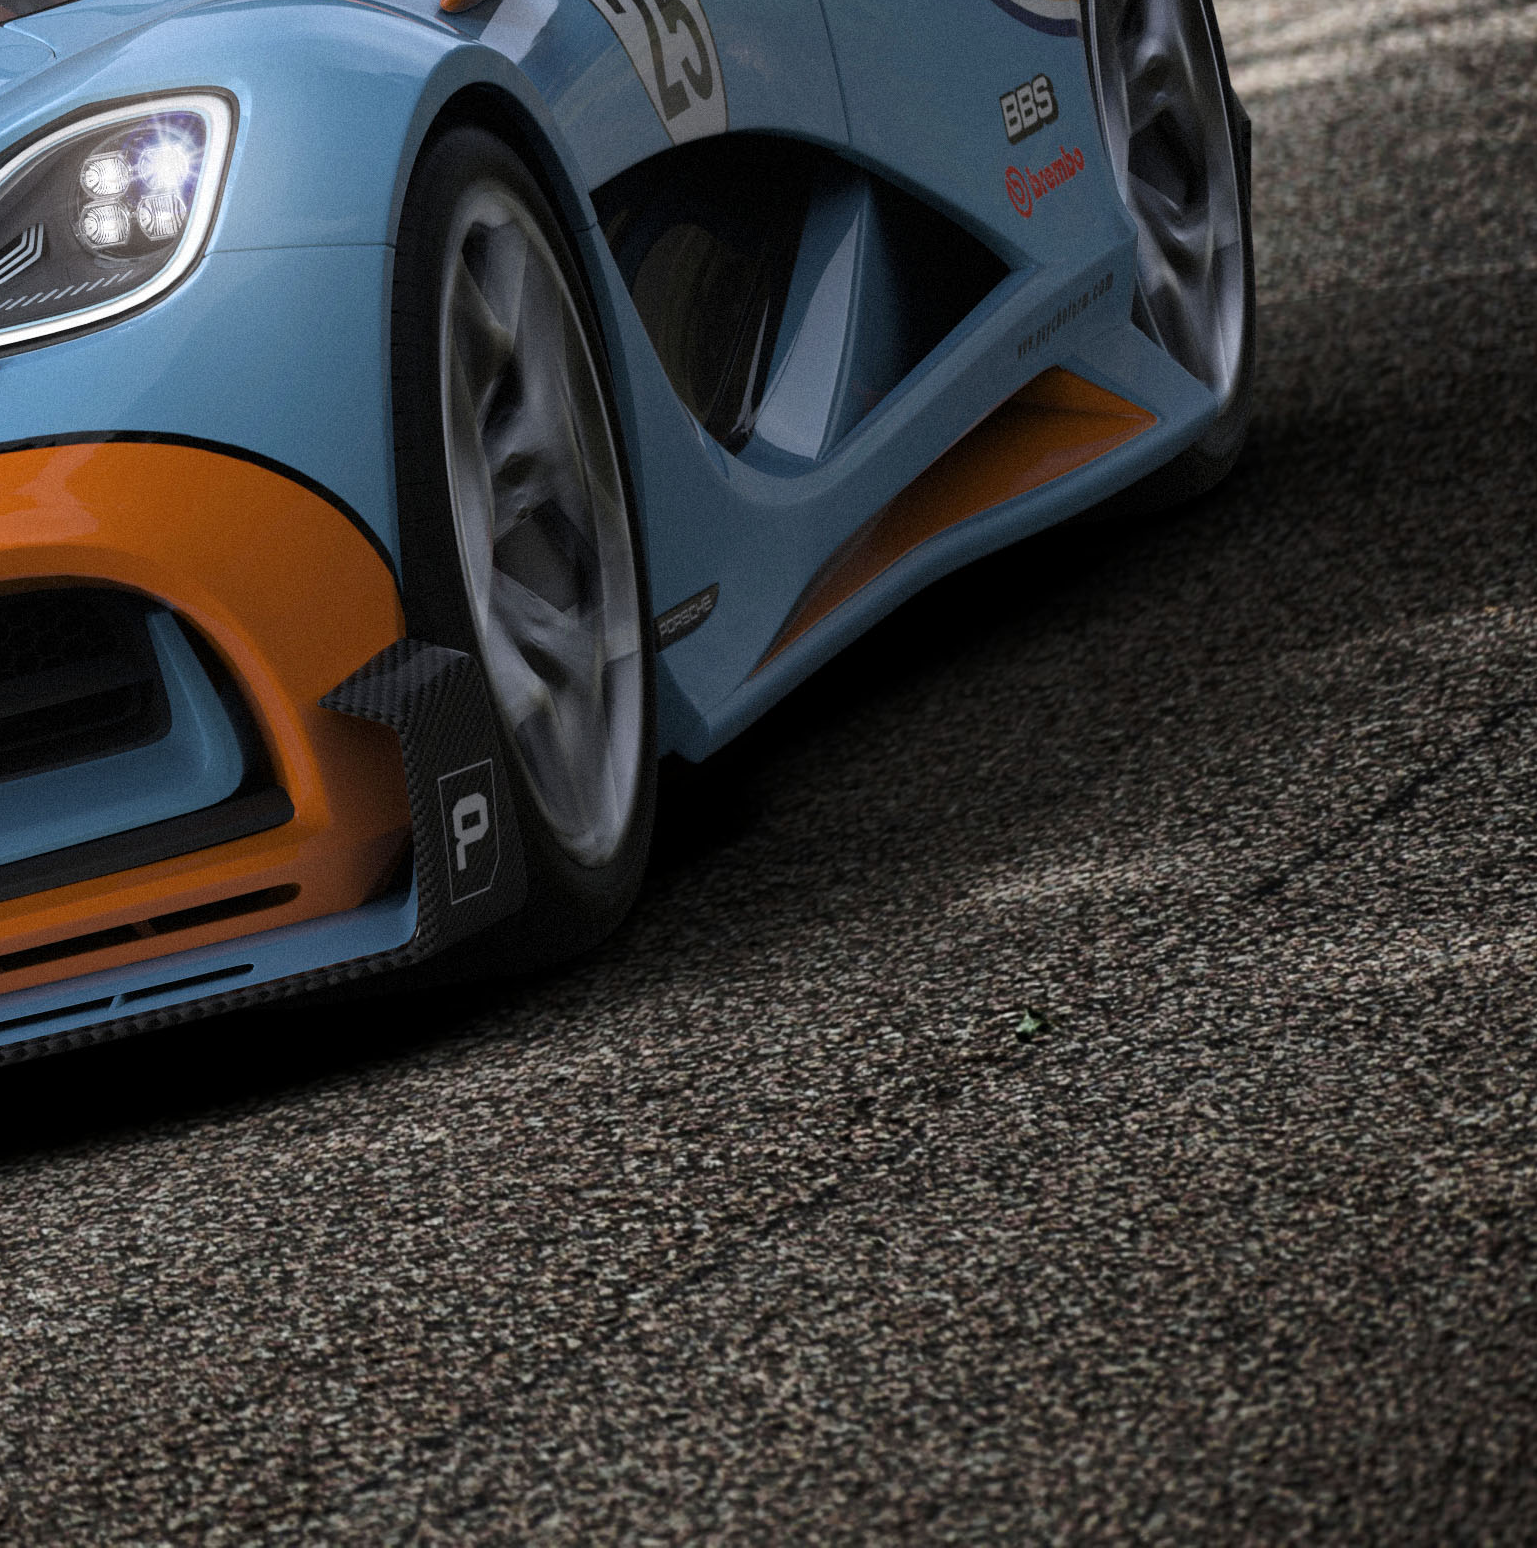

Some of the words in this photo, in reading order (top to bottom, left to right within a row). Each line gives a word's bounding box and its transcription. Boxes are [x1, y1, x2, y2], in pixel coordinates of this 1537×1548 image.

[999, 73, 1059, 145] BBS
[1025, 145, 1085, 200] brembo
[659, 594, 714, 637] PORSCHE
